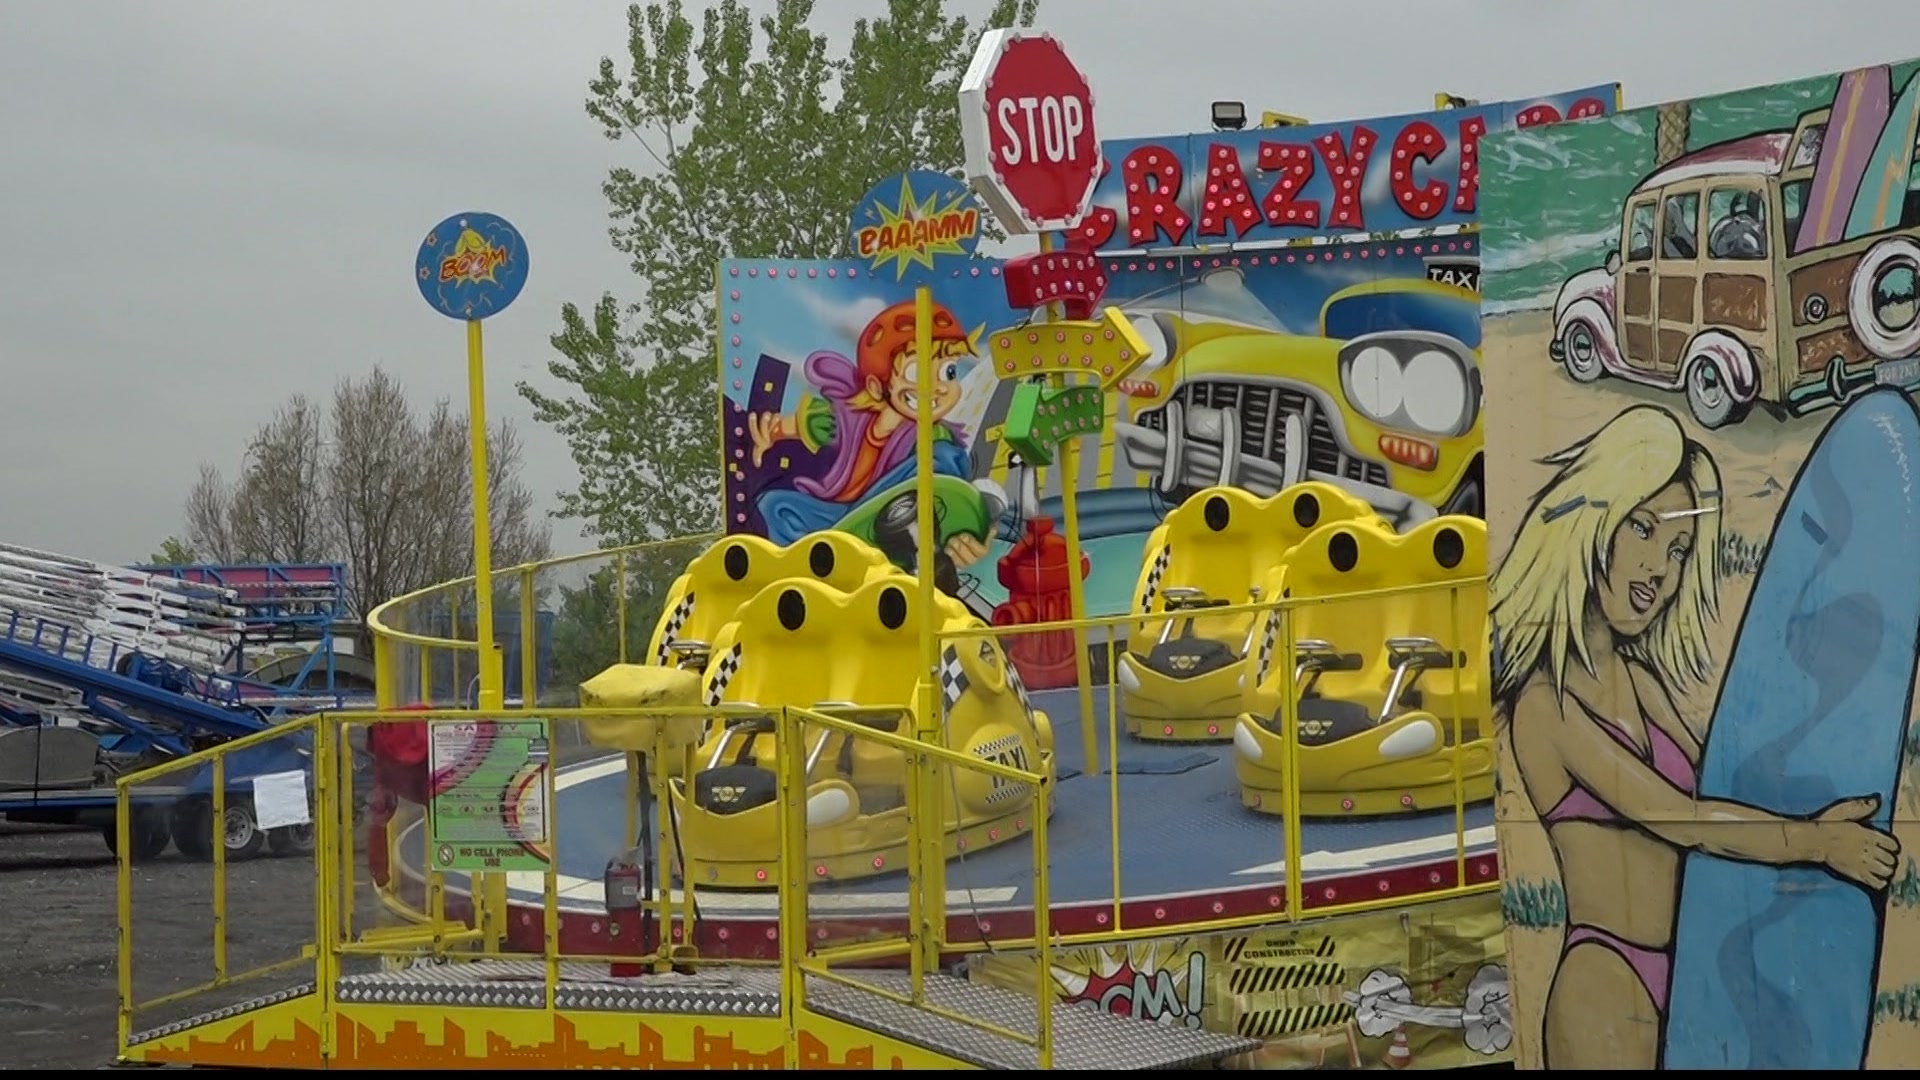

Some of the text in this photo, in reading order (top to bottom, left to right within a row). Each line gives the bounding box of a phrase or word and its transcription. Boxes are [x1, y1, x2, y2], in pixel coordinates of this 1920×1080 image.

[998, 95, 1084, 165] STOP
[858, 207, 979, 257] BAAAMM
[439, 244, 507, 283] BOOM
[1430, 268, 1481, 293] TAXI
[983, 744, 1029, 789] TAXI
[459, 847, 526, 857] NO CELL PHONE
[484, 858, 501, 867] USE
